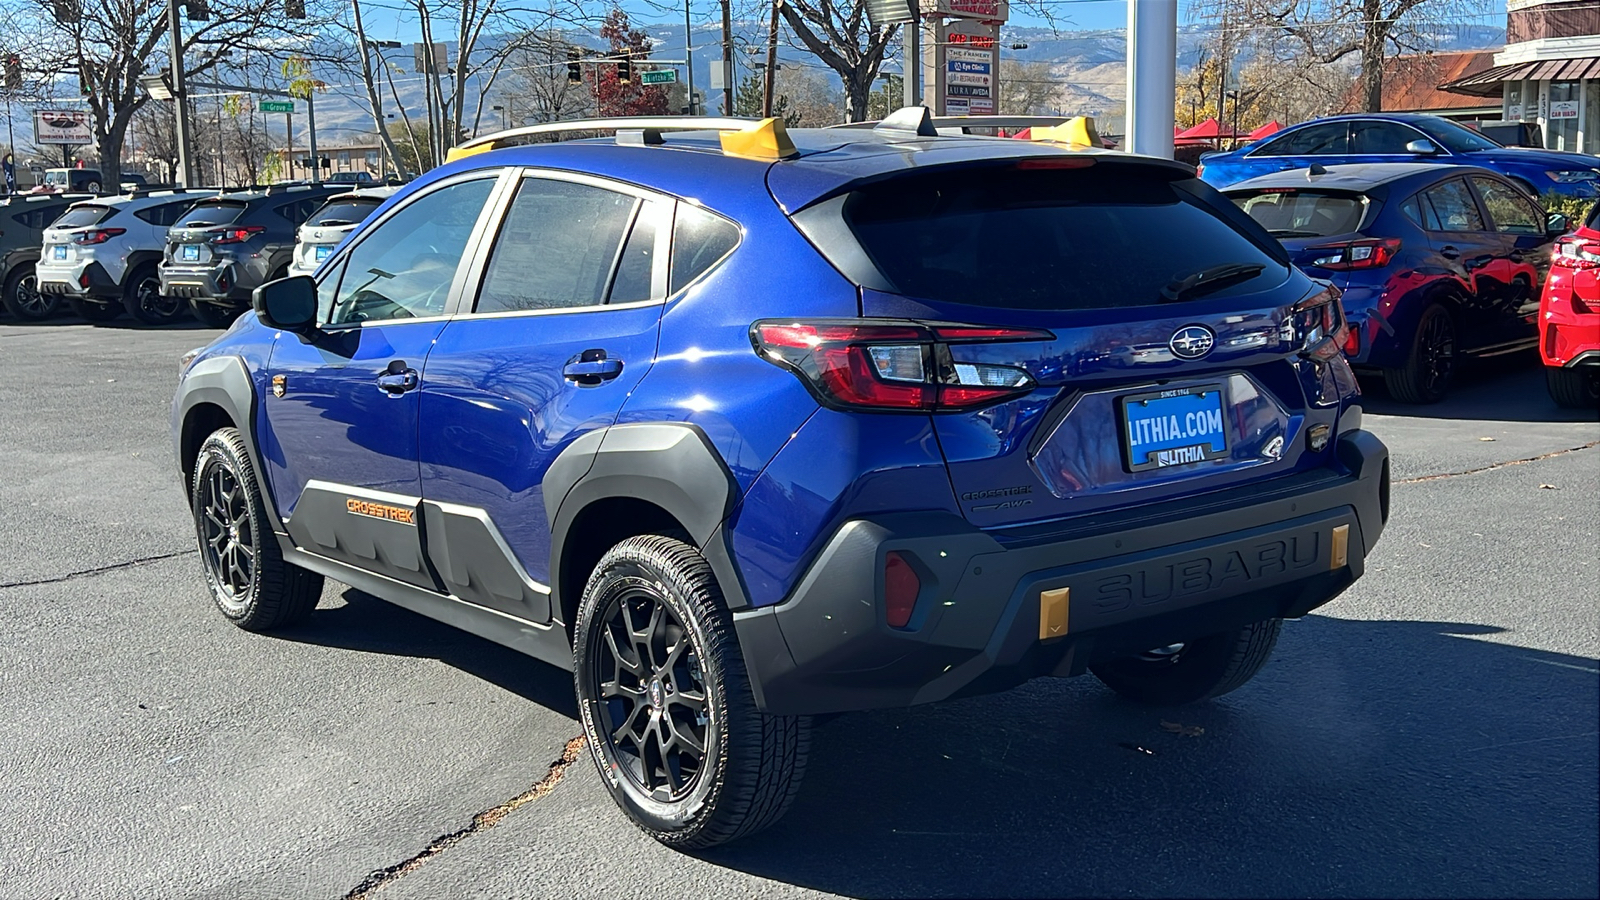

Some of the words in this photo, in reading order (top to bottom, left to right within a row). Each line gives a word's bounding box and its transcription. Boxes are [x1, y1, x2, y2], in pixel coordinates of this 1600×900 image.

[962, 63, 971, 71] Eye
[949, 86, 969, 95] AURA
[971, 88, 989, 96] AVEDA
[1161, 390, 1177, 398] SINCE
[1128, 408, 1223, 447] LITHIA.COM
[1168, 445, 1206, 466] LITHIA
[961, 484, 1033, 501] CROSSTREK
[346, 498, 414, 523] CROSSTREK
[1096, 531, 1320, 615] SUBARU
